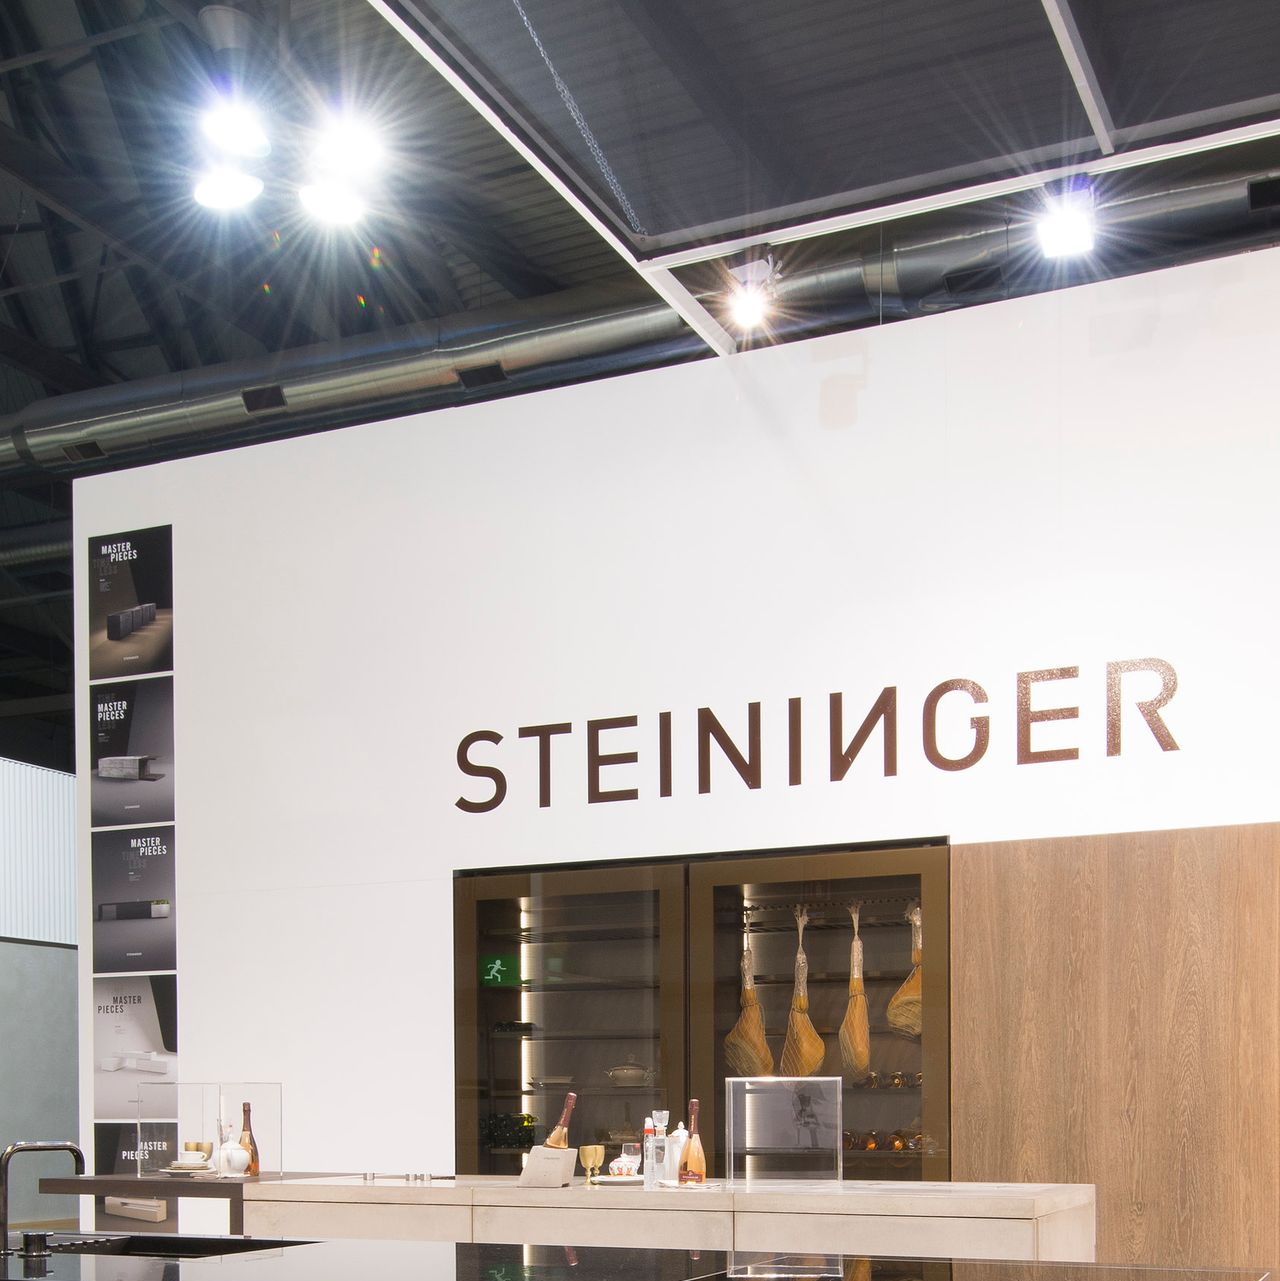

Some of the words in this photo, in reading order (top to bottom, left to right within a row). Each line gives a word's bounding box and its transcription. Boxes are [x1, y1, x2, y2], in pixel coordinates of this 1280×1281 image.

[101, 542, 131, 555] MASTER
[110, 549, 138, 563] PIECES
[97, 701, 128, 713] MASTER
[97, 710, 125, 722] PIECES
[454, 656, 1182, 814] STEININGER
[130, 836, 161, 848] MASTER
[139, 845, 167, 856] PIECES
[112, 995, 142, 1005] MASTER
[97, 1004, 124, 1014] PIECES
